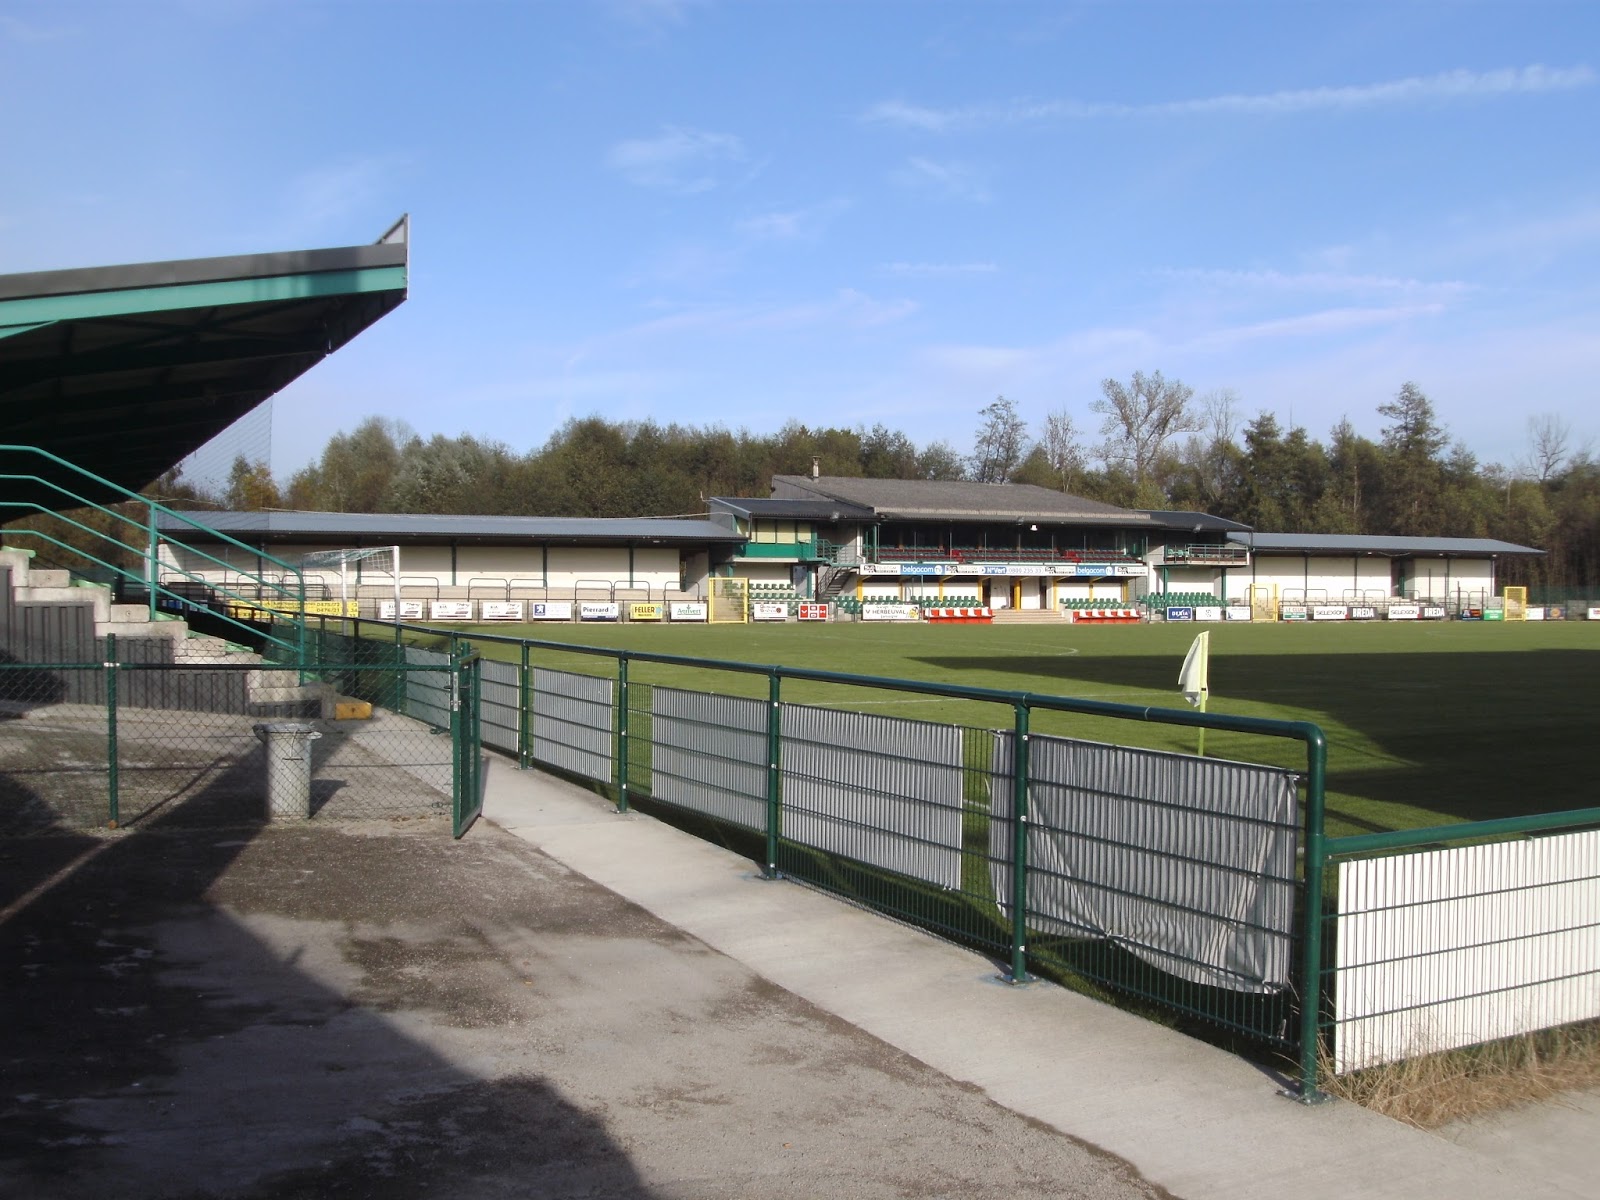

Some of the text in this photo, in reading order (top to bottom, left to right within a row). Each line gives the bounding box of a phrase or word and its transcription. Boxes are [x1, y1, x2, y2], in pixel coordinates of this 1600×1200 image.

[902, 565, 934, 574] belgacom
[1077, 567, 1105, 575] belgacom
[634, 606, 655, 614] FELLER
[1171, 609, 1188, 617] DEXIA
[1352, 607, 1375, 617] BREDA
[1424, 607, 1446, 617] BREDA
